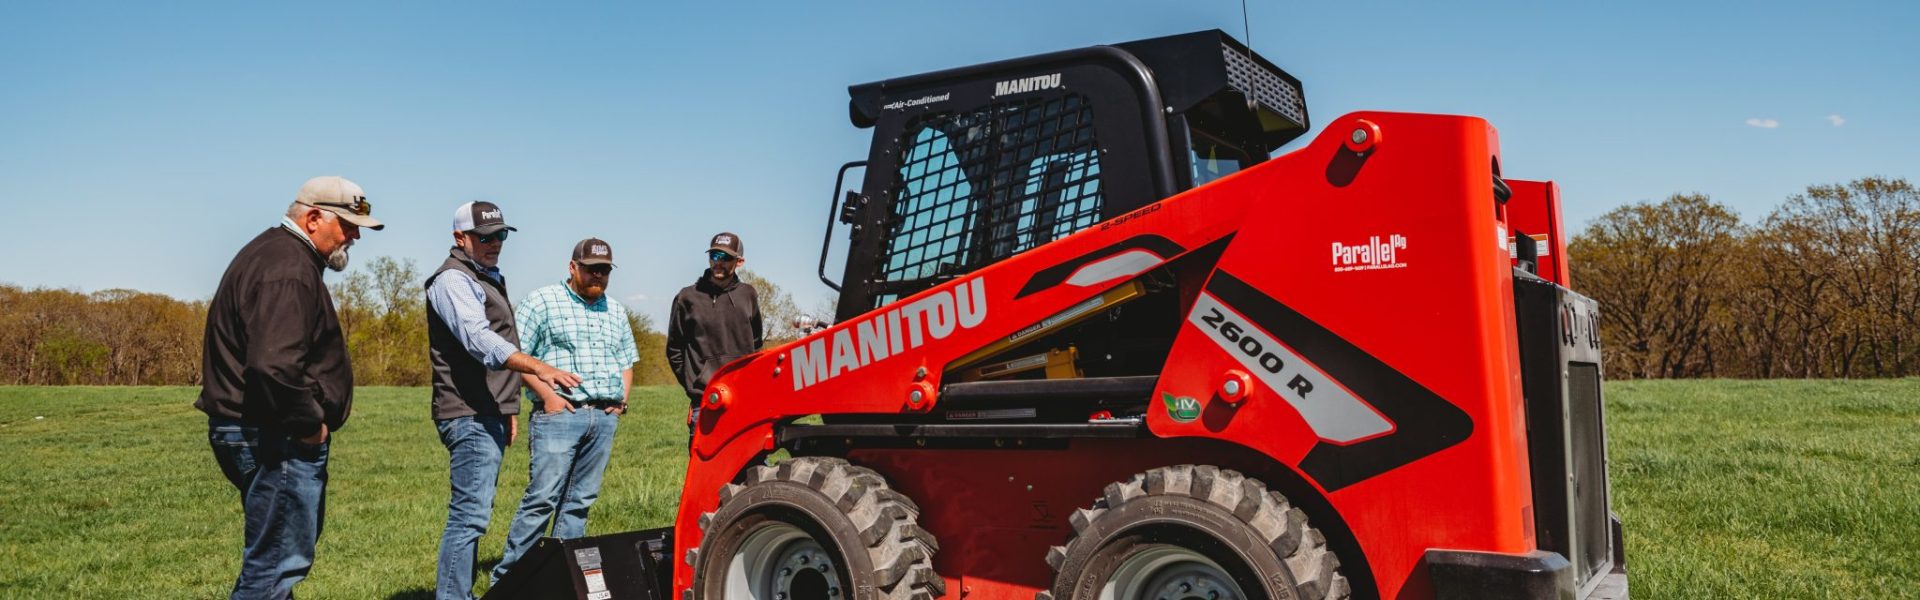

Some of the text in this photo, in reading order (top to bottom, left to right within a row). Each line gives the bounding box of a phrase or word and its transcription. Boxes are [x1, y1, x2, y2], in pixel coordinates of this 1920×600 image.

[995, 73, 1061, 97] MANITOU
[893, 92, 950, 109] Air-Conditioned
[1101, 203, 1162, 231] 2-SPEED
[1332, 234, 1396, 265] Parallel
[790, 276, 988, 391] MANITOU
[1201, 307, 1314, 400] 2600 R
